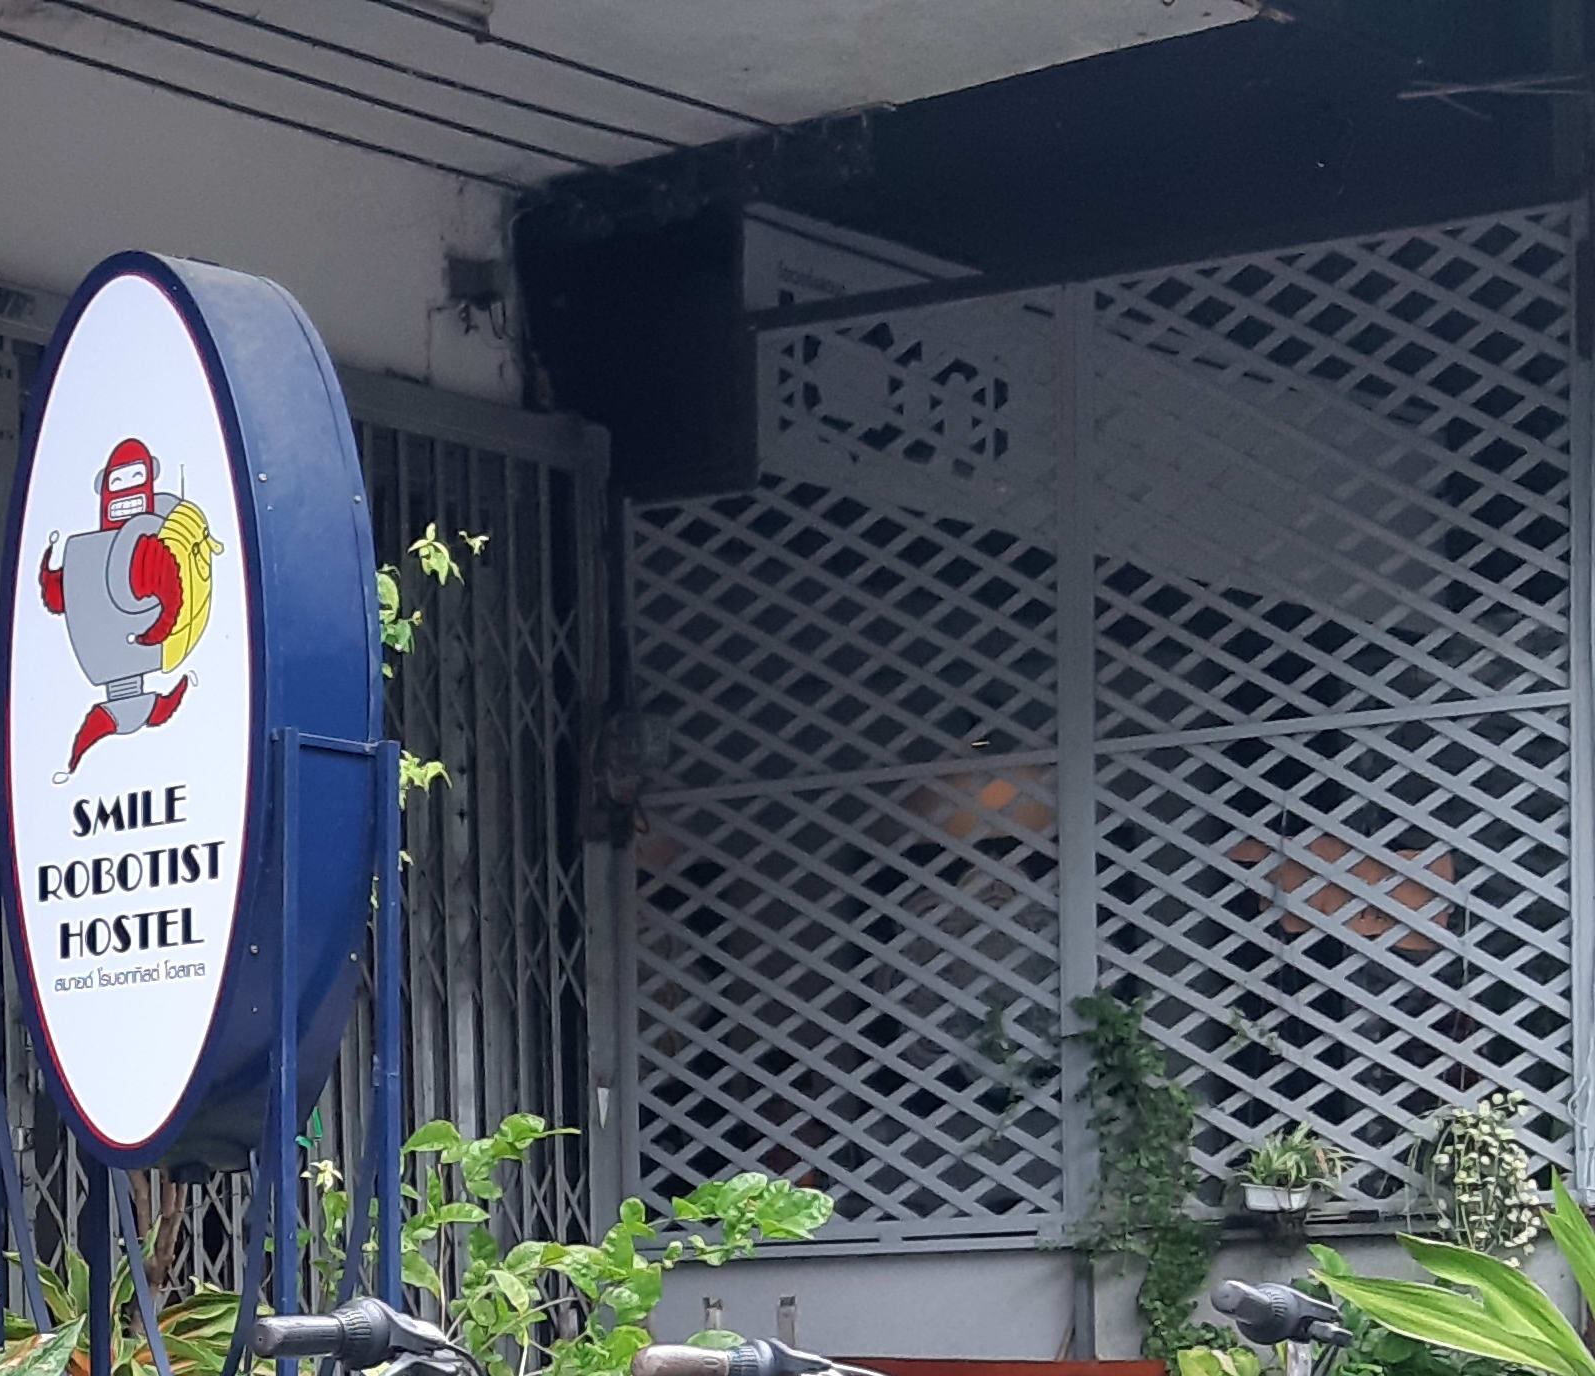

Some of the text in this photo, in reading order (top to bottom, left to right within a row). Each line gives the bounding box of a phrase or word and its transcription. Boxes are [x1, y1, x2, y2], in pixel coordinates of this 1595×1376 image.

[71, 784, 188, 838] SMILE
[37, 840, 226, 903] ROBOTIST
[58, 906, 206, 960] HOSTEL
